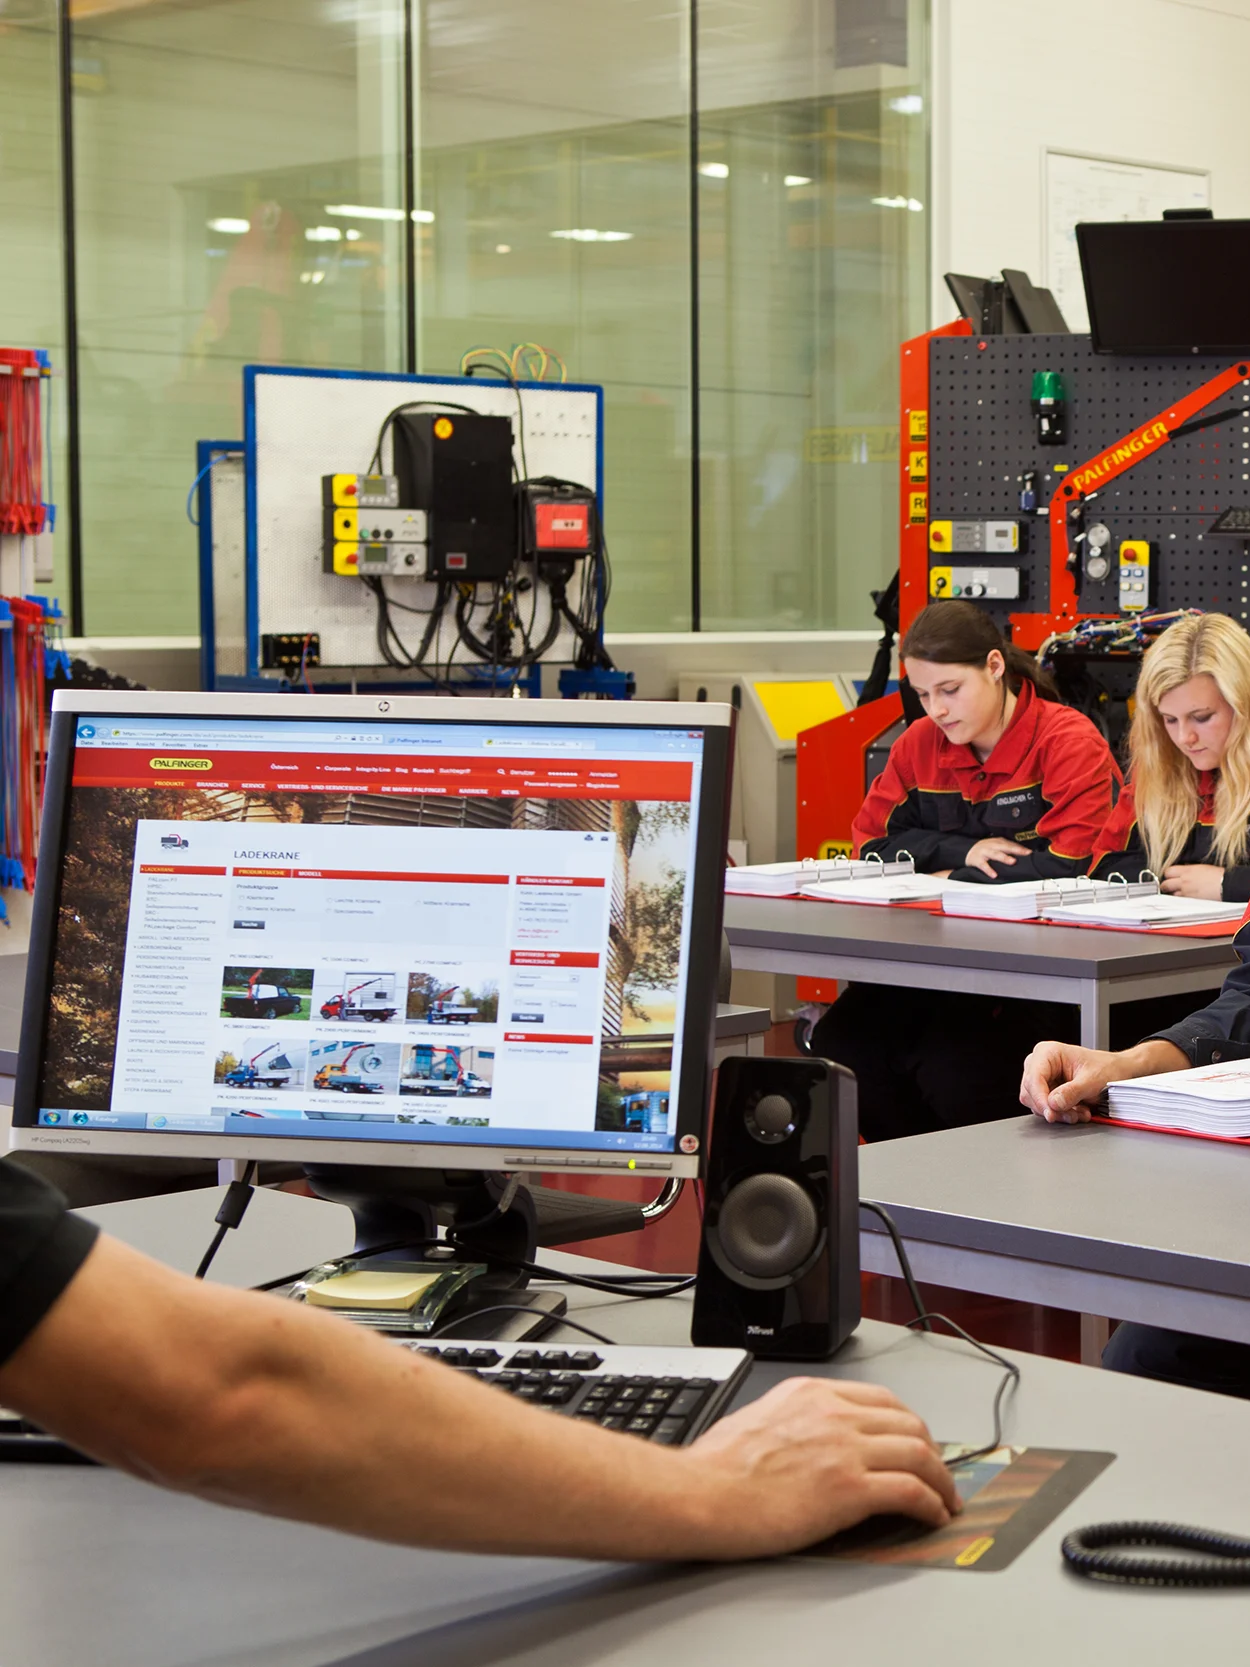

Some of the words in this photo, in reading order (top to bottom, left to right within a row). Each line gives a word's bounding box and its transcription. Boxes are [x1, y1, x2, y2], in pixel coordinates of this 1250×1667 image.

[1073, 422, 1168, 490] PALFINGER
[154, 760, 208, 768] PALFINGER
[234, 850, 300, 860] LADEKRANE
